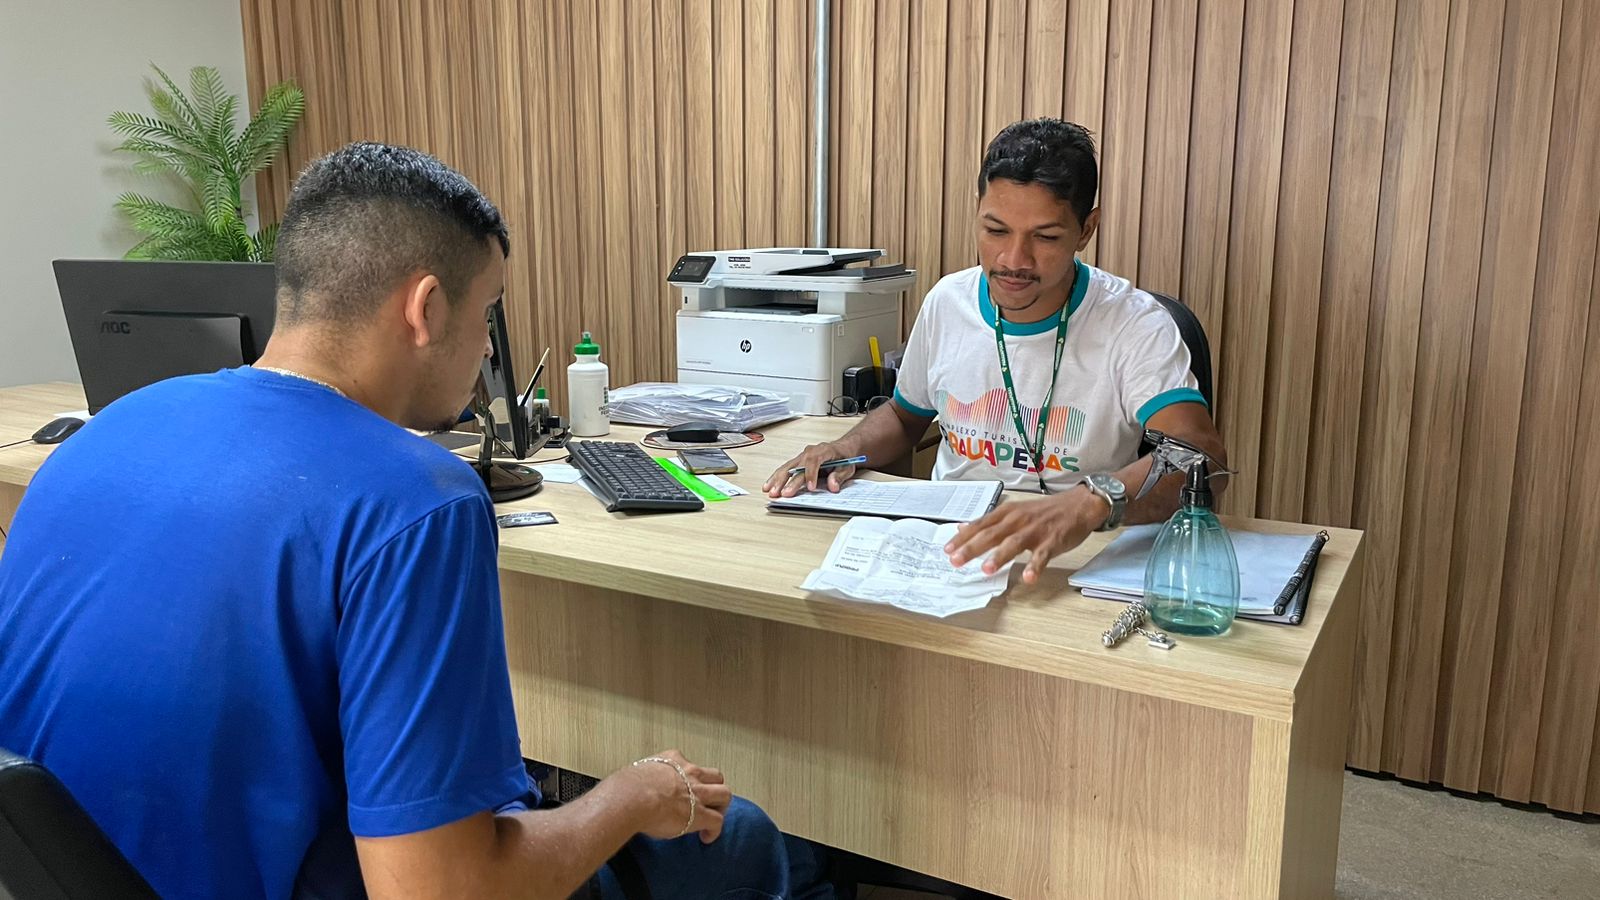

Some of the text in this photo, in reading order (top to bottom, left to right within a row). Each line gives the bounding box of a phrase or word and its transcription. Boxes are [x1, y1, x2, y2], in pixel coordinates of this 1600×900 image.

[100, 321, 131, 334] AOC
[740, 339, 752, 353] hp
[1054, 446, 1068, 456] DE
